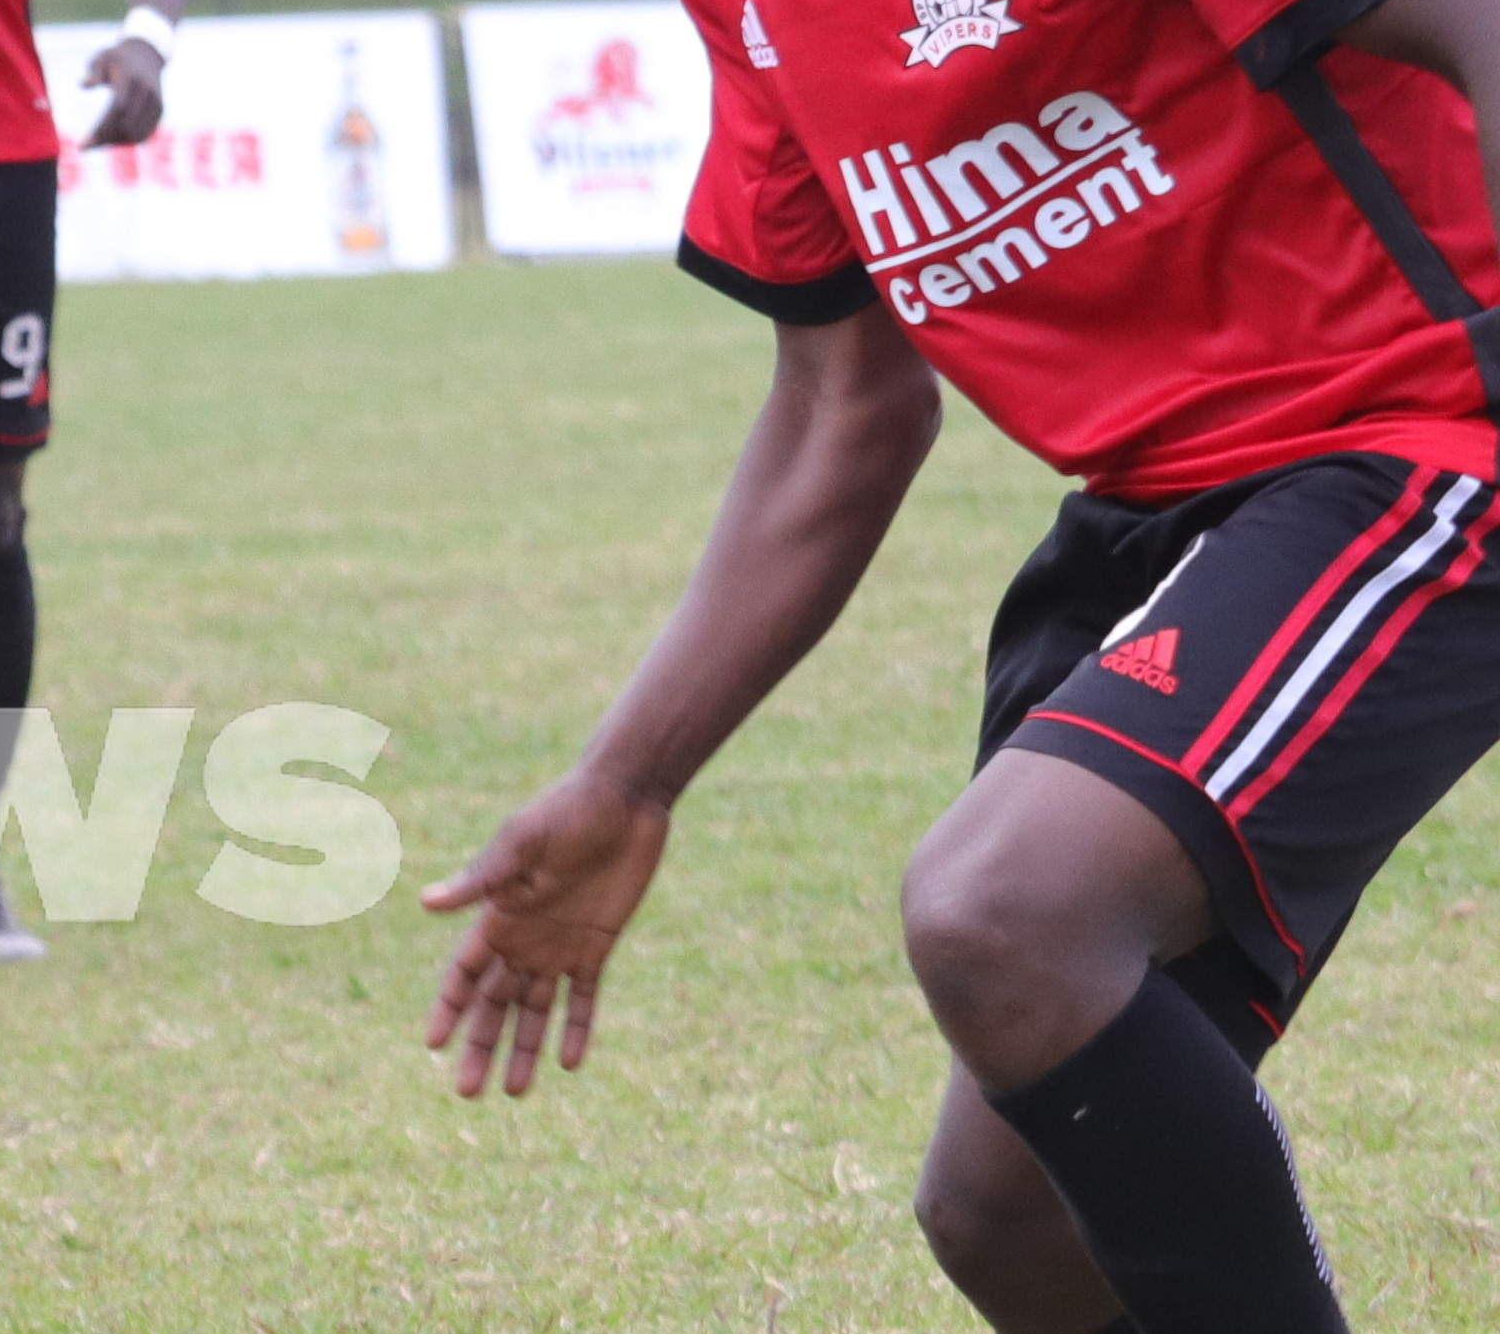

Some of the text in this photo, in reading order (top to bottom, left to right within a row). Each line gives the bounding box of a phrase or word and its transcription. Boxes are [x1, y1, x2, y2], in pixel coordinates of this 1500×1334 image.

[928, 22, 992, 55] VIPERS
[838, 91, 1133, 256] Hima
[889, 139, 1175, 325] cement
[1100, 652, 1180, 697] adidas
